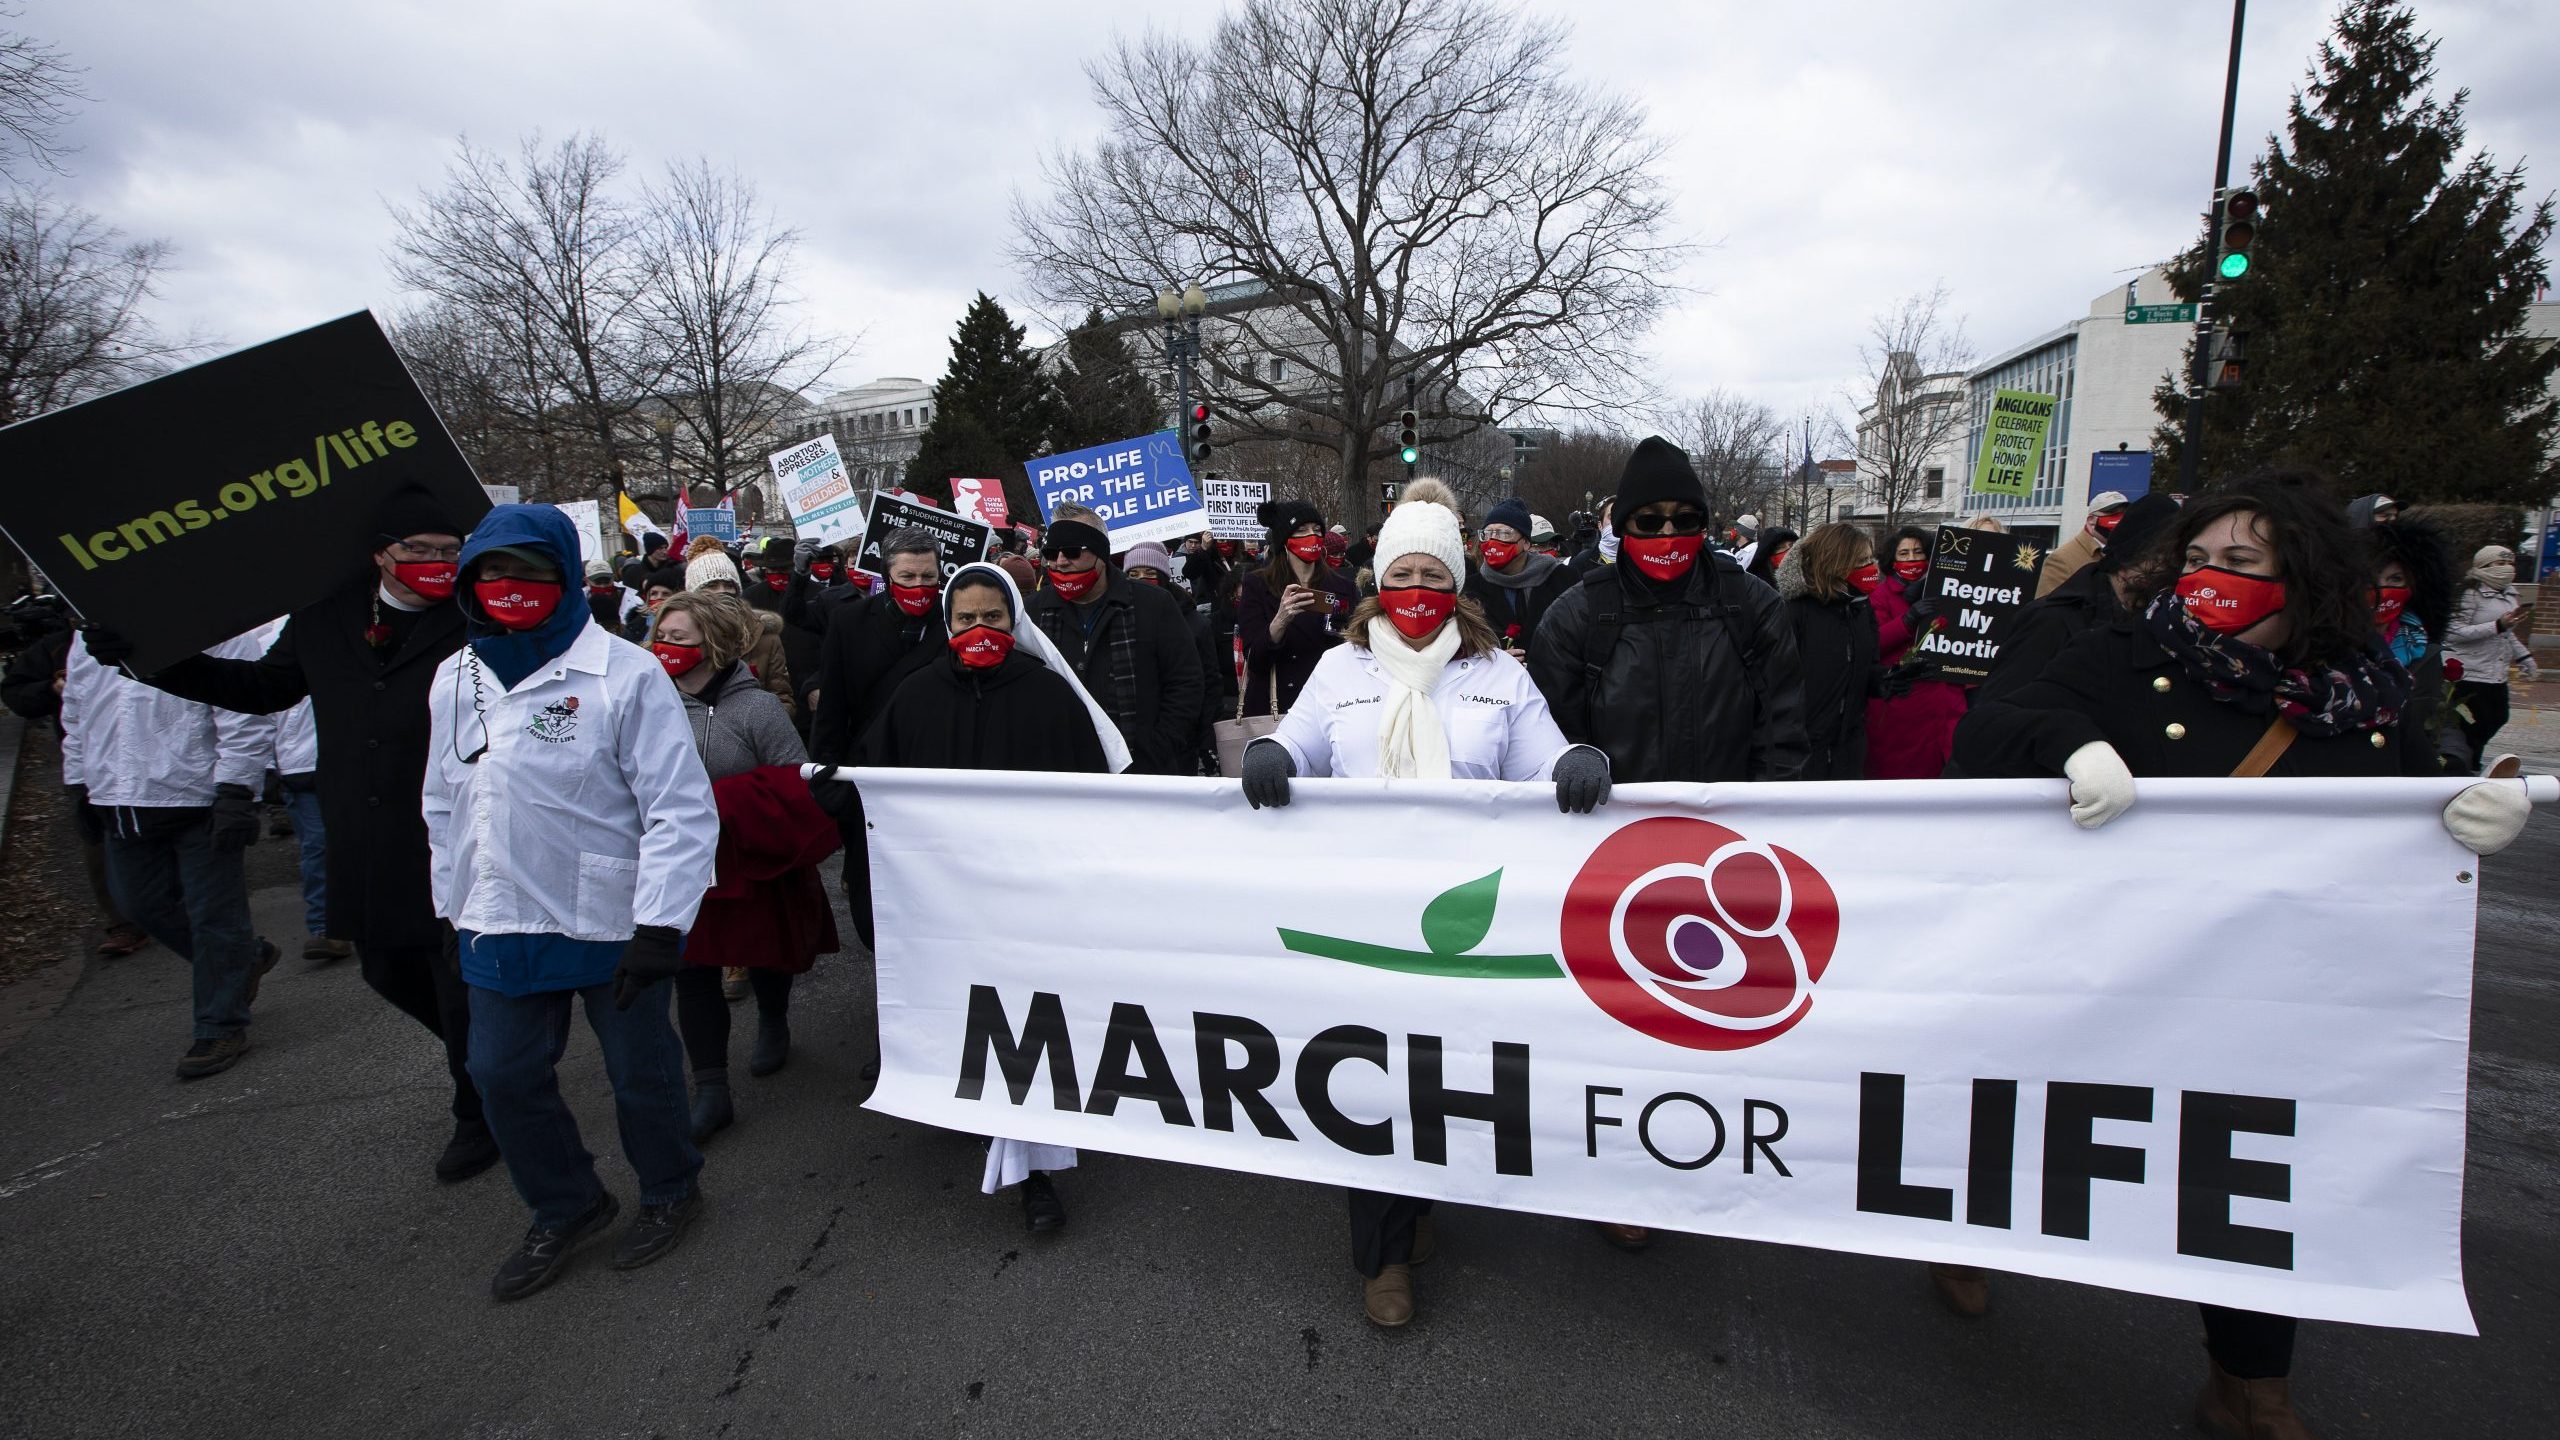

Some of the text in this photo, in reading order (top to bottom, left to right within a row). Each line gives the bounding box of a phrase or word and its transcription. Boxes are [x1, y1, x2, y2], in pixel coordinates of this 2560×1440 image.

[2223, 365, 2239, 382] 19
[1994, 397, 2053, 417] ANGLICANS
[1995, 416, 2044, 433] CELEBRATE
[1993, 434, 2035, 450] PROTECT
[777, 441, 822, 469] ABORTION
[778, 448, 829, 478] OPPRESSES:
[1992, 451, 2027, 467] HONOR
[799, 455, 838, 481] MOTHERS
[1038, 448, 1143, 487] PRO-LIFE
[788, 468, 841, 501] FATHERS &
[1987, 468, 2024, 486] LIFE
[58, 420, 419, 571] lcms.org/life
[801, 480, 847, 510] CHILDREN
[1046, 472, 1146, 510] FOR THE
[1145, 484, 1191, 511] LIFE
[1206, 483, 1262, 498] LIFE IS THE
[811, 510, 825, 519] MEN
[825, 504, 842, 513] LOVE
[1207, 500, 1233, 513] FIRST
[688, 511, 733, 523] CHOOSE LOVE
[908, 508, 966, 530] STUDENTS FOR LIFE
[714, 523, 730, 533] LIFE
[881, 512, 908, 528] THE
[962, 536, 976, 548] IS
[1643, 553, 1689, 566] MARCH LIFE
[1983, 553, 1994, 572] I
[418, 576, 445, 584] MARCH
[1941, 577, 2022, 605] Regret
[487, 599, 540, 609] MARCH LIFE
[2215, 598, 2238, 608] LIFE
[1395, 607, 1417, 619] MARCH
[1425, 609, 1437, 617] LIFE
[1959, 608, 1994, 635] My
[1471, 695, 1510, 706] AAPLOG
[529, 728, 577, 743] RESPECT LIFE
[954, 983, 2297, 1271] MARCH FOR LIFE
